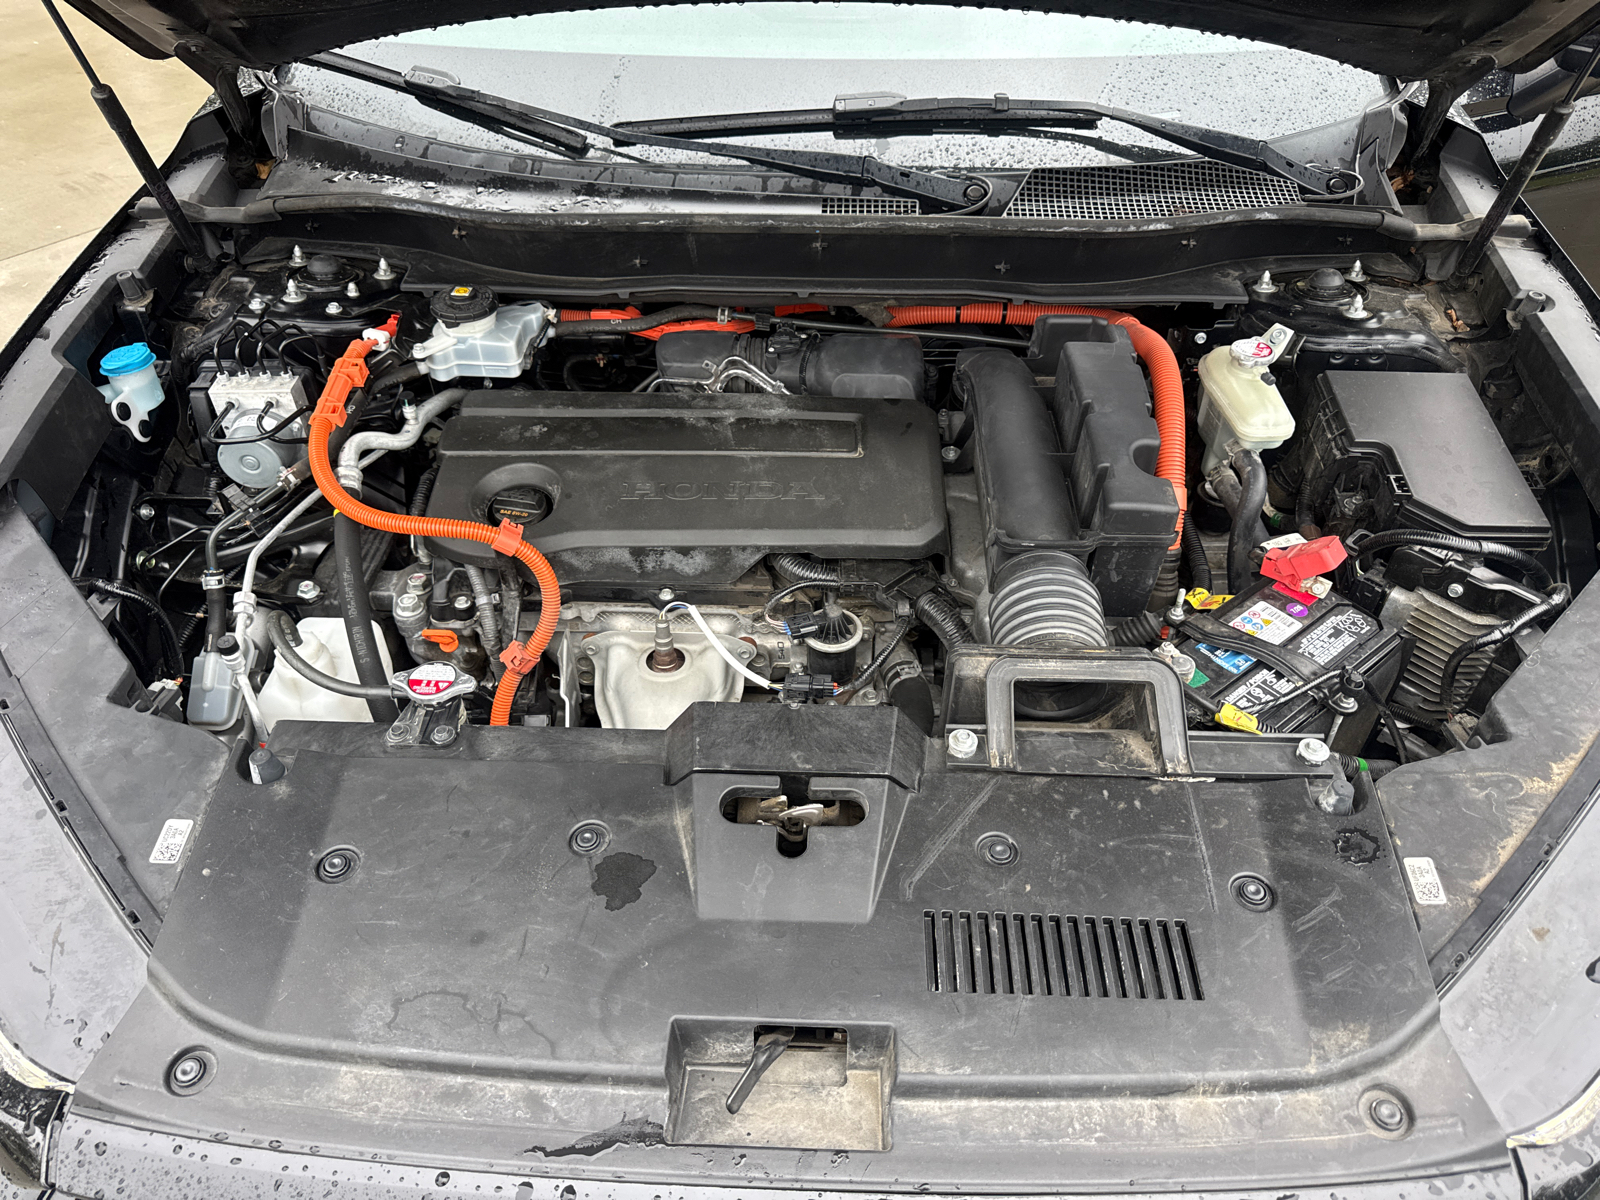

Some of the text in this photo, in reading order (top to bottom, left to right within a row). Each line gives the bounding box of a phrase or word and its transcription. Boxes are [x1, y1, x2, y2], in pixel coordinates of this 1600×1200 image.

[620, 481, 826, 500] HONDA
[1225, 684, 1248, 702] DANGER
[1249, 668, 1270, 685] POISON
